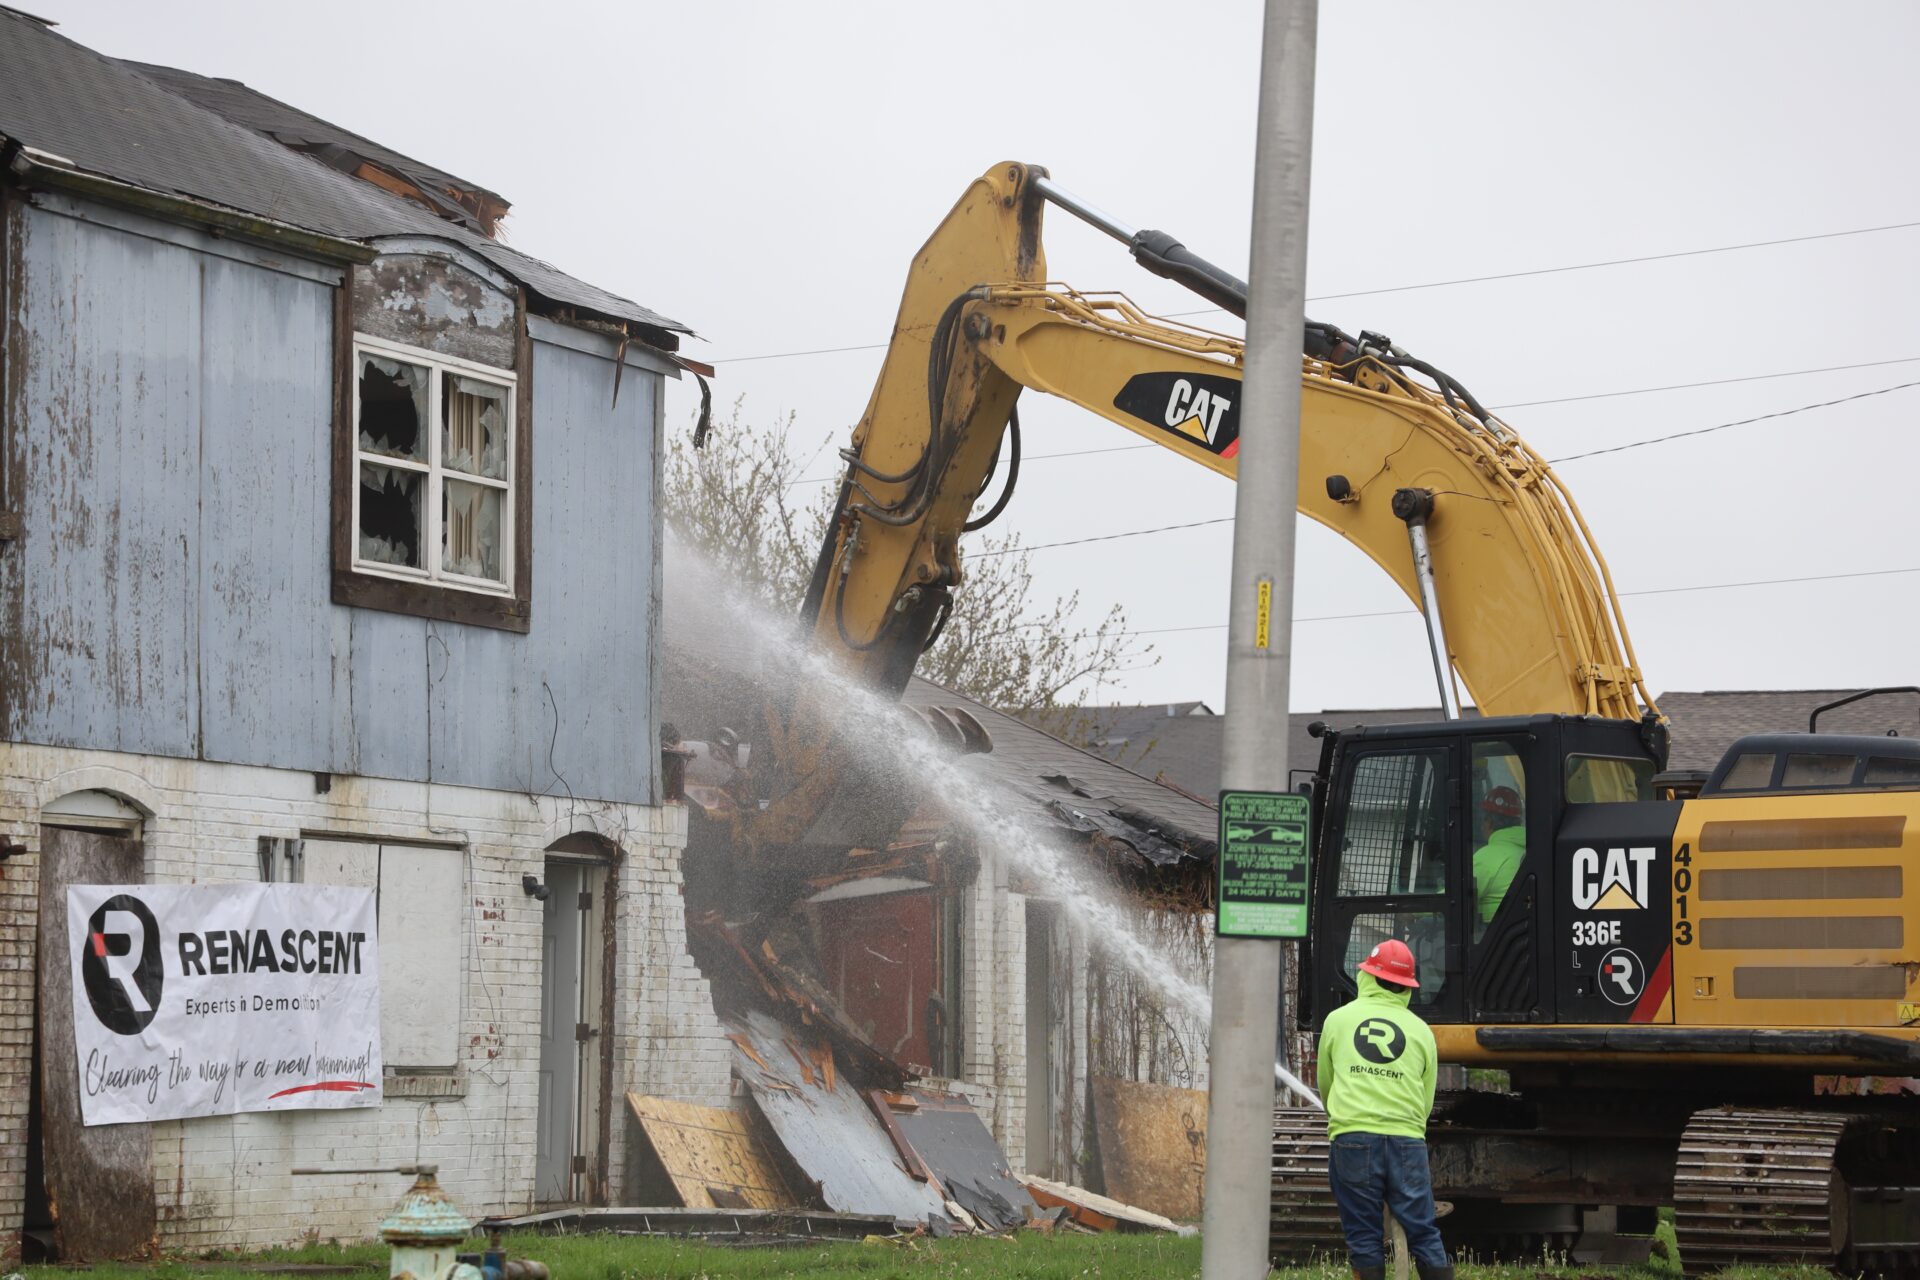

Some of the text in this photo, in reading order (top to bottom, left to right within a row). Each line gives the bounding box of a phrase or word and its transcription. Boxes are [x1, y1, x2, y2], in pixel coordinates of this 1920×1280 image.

[1164, 378, 1231, 446] CAT
[1572, 847, 1656, 910] CAT
[1674, 843, 1693, 946] 4013
[178, 929, 366, 977] RENASCENT
[1572, 920, 1621, 946] 336E
[1607, 956, 1635, 995] R
[186, 998, 236, 1018] Experts
[85, 1048, 162, 1104] Clearing
[169, 1048, 192, 1089] the
[200, 1060, 231, 1104] way
[254, 1058, 269, 1078] a
[275, 1054, 312, 1077] new
[1350, 1065, 1404, 1080] RENASCENT
